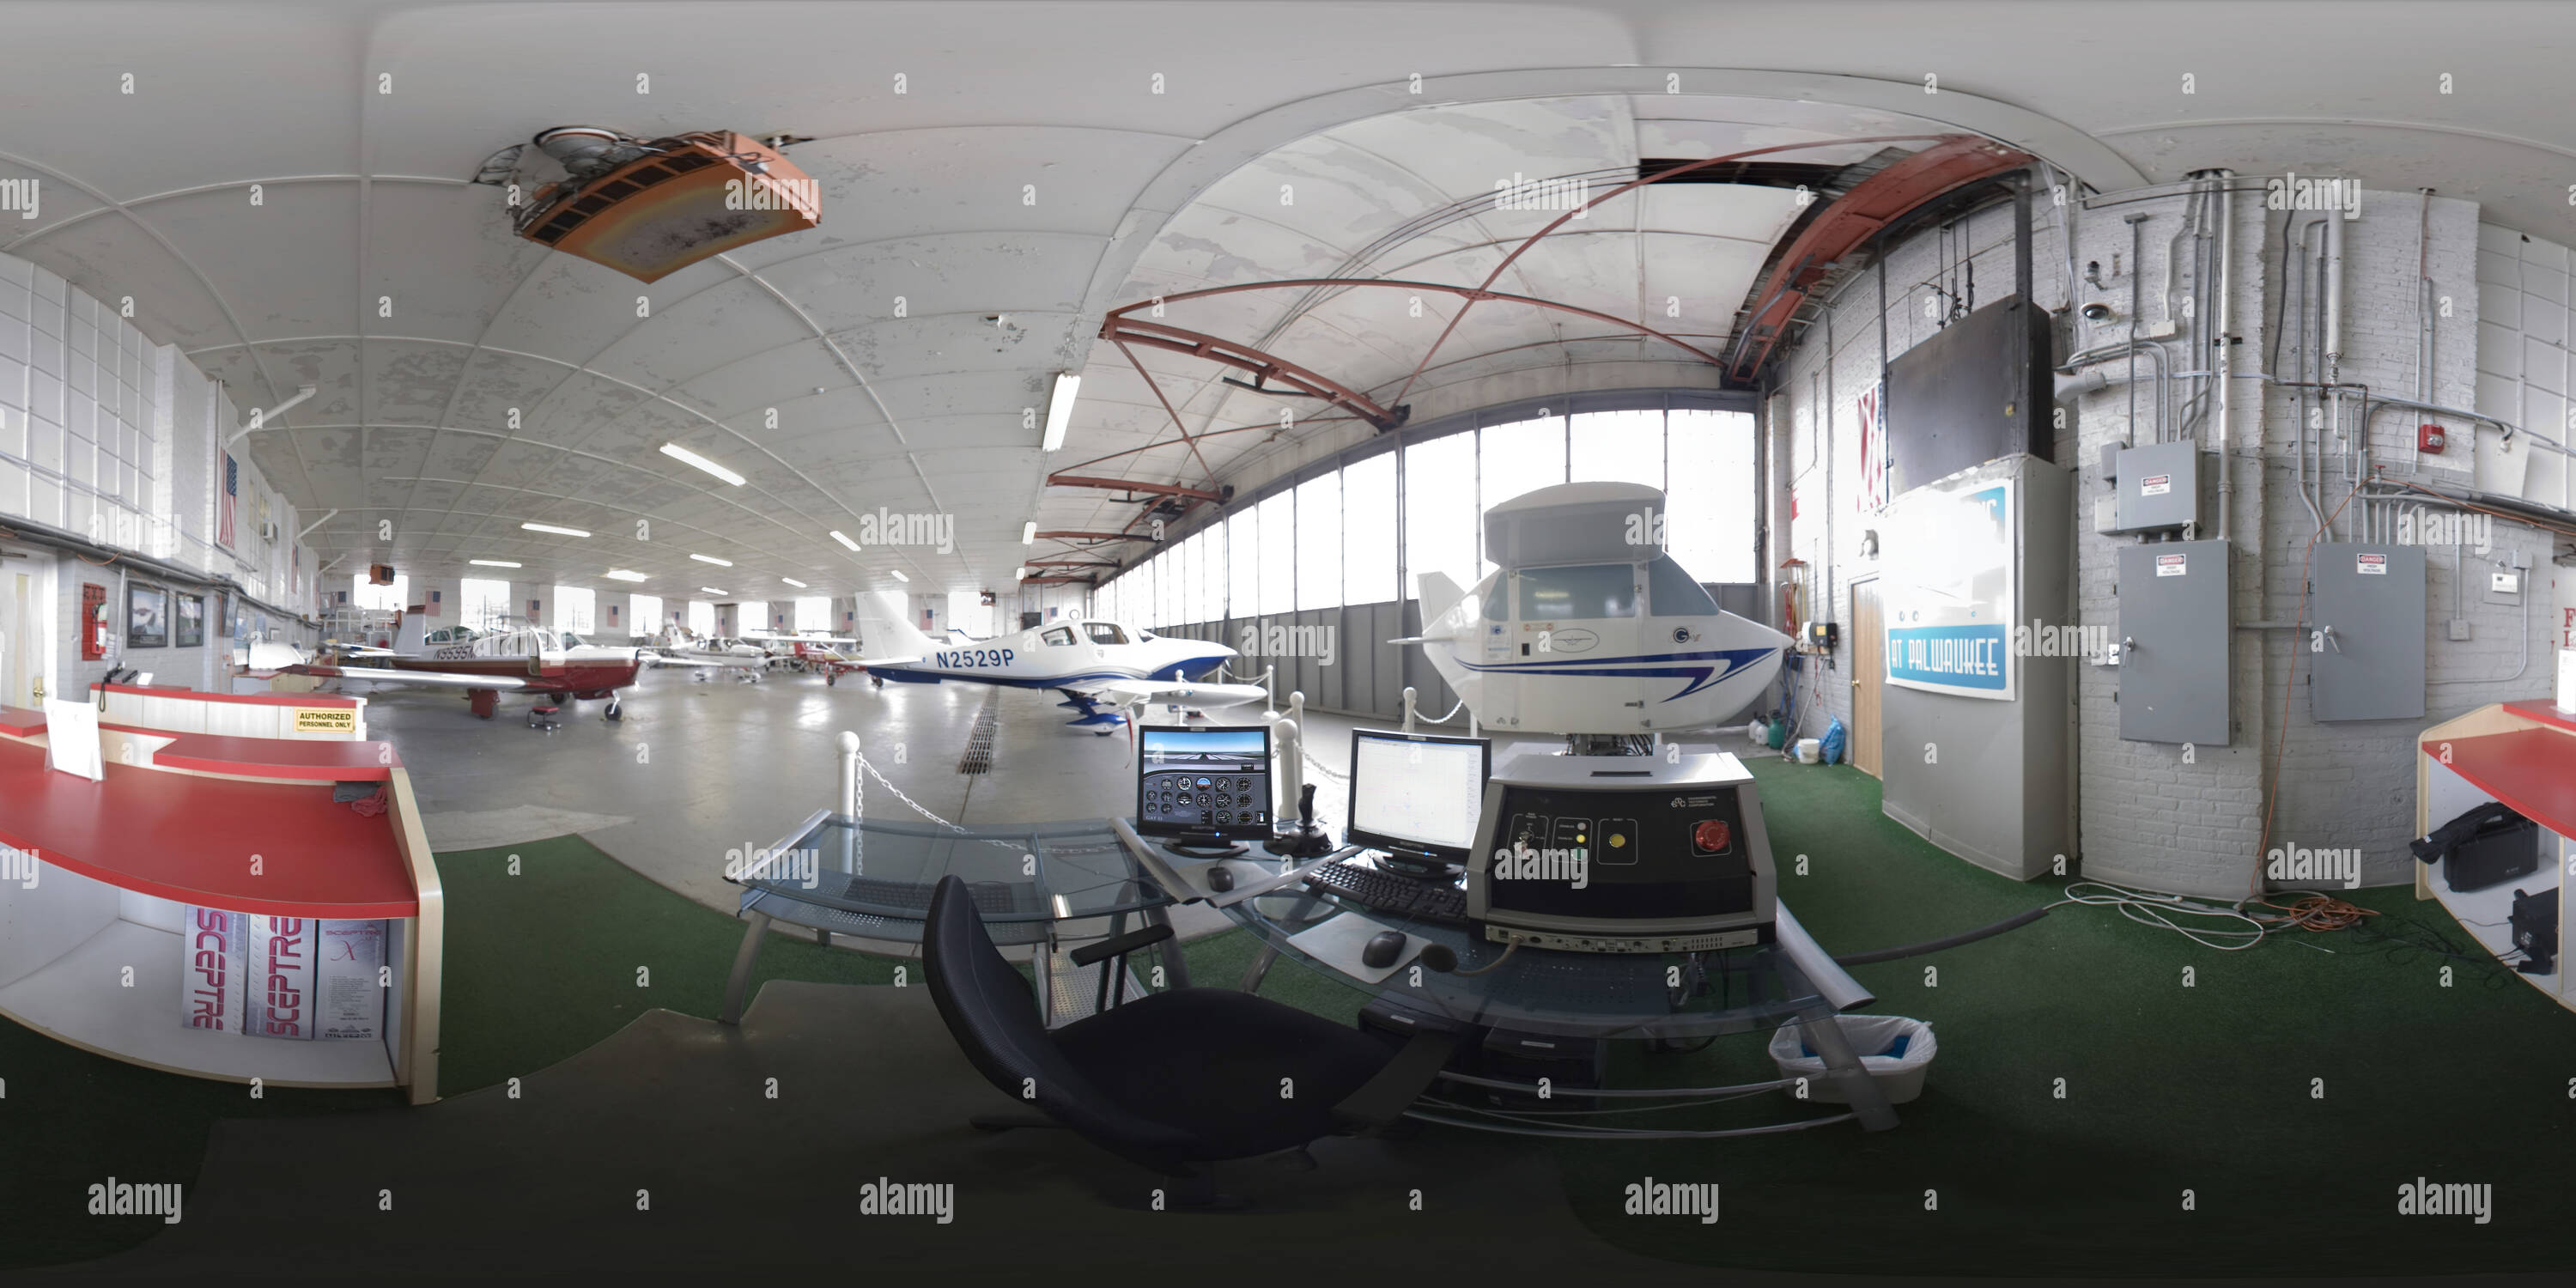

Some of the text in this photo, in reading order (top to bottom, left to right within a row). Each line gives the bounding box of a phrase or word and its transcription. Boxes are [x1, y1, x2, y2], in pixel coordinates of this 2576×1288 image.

[936, 648, 1014, 668] N2529P
[1892, 638, 1999, 676] AT PALWAUKEE
[192, 908, 227, 1031] SCEPTRE
[267, 916, 301, 1037] SCEPTRE
